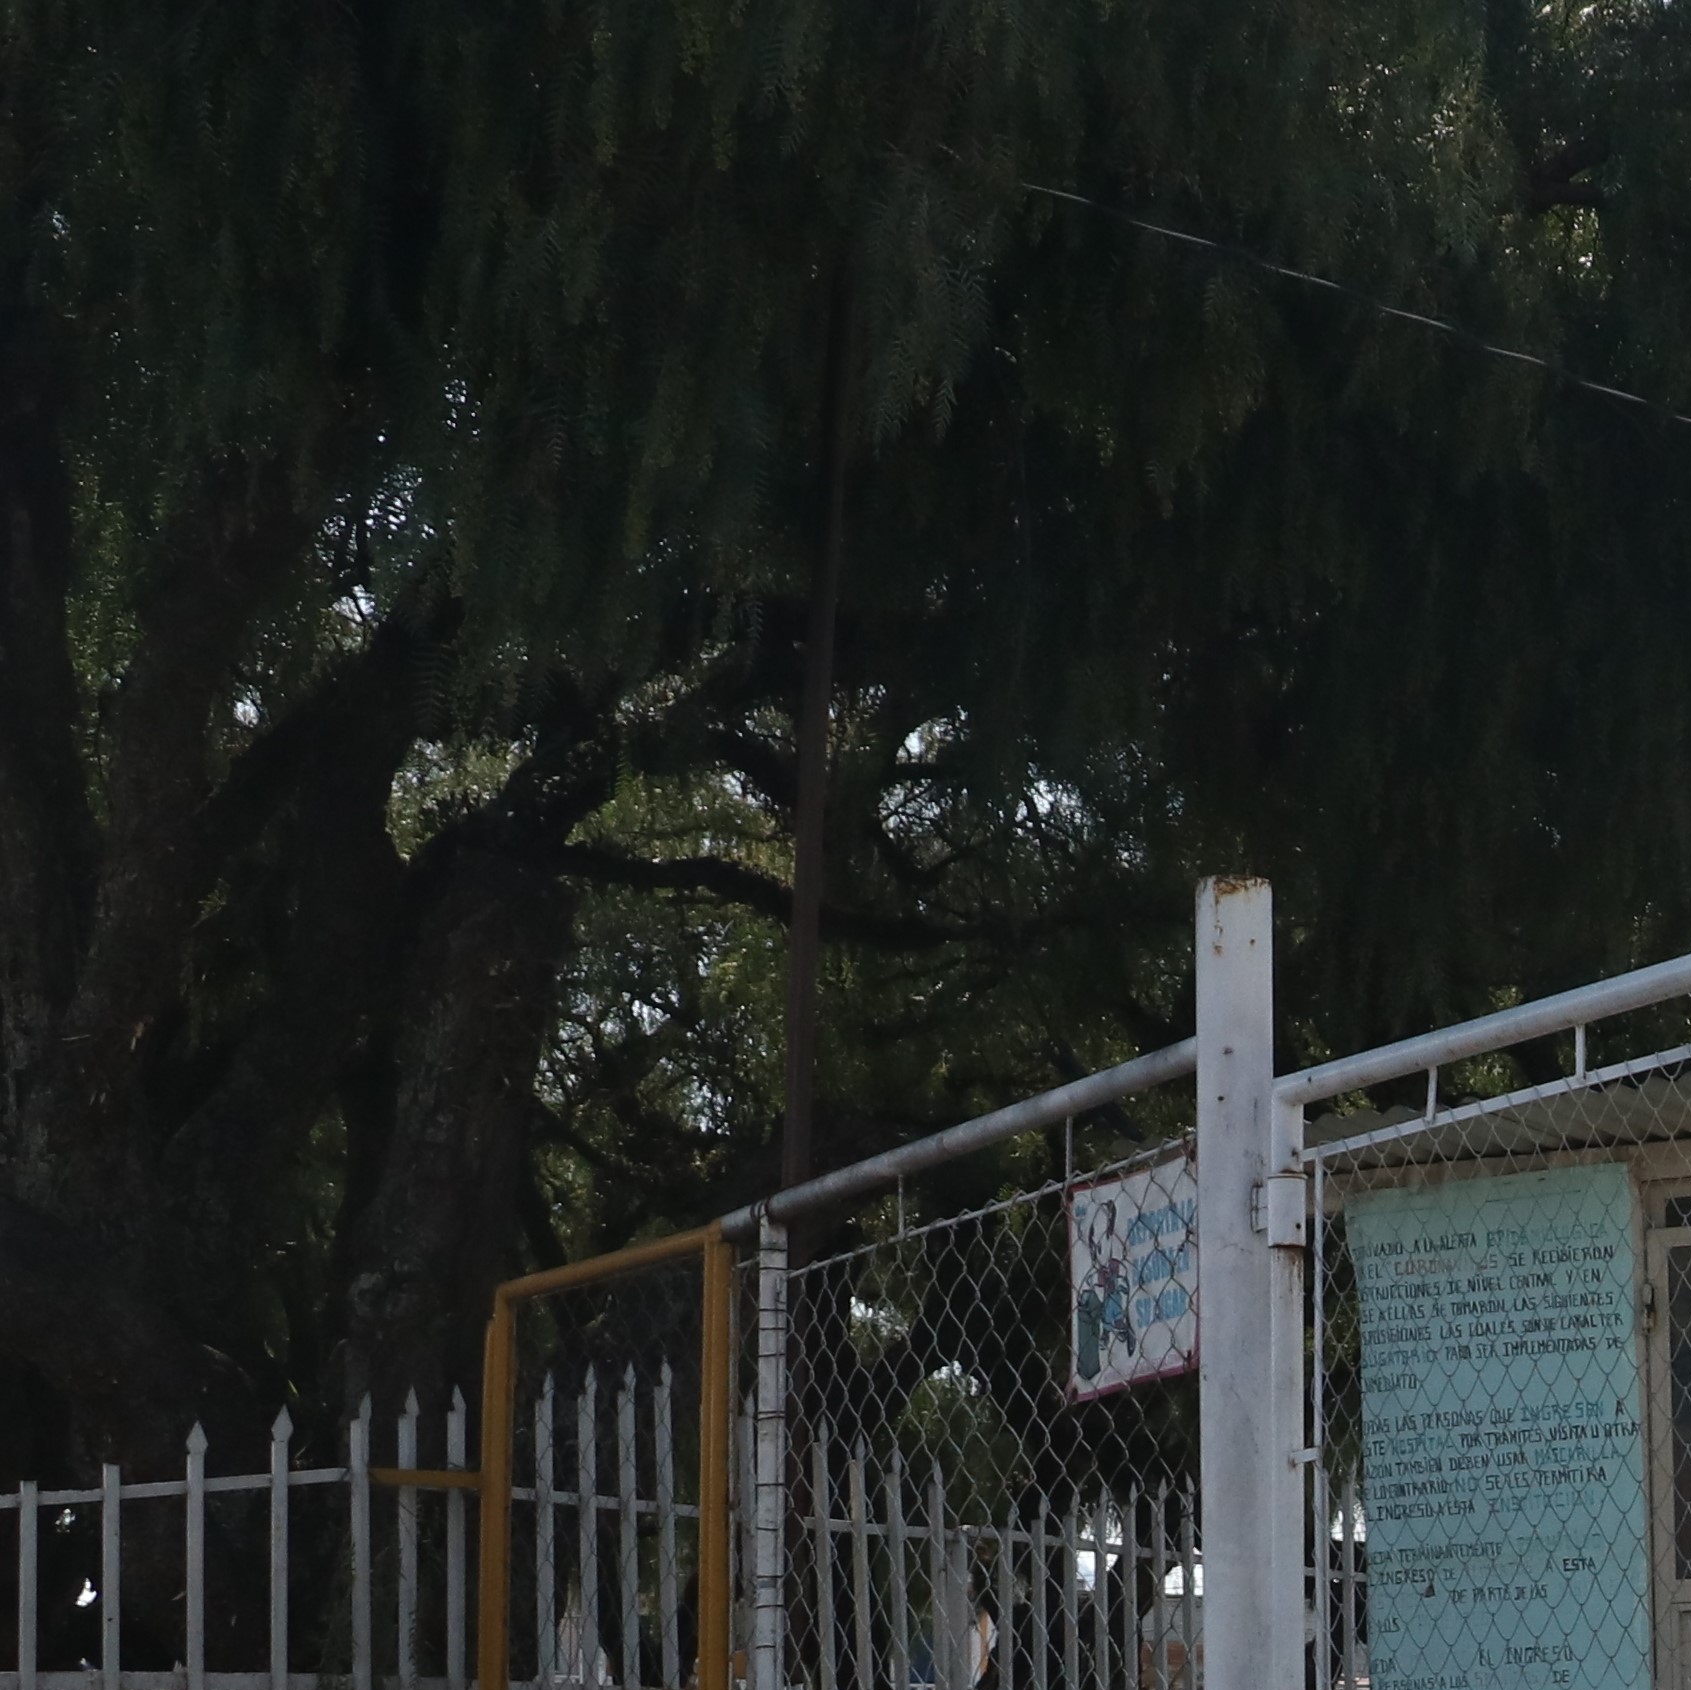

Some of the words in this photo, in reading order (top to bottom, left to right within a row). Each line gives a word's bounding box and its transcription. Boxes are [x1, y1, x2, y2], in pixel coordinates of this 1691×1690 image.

[1583, 1268, 1601, 1284] EN
[1513, 1297, 1536, 1312] LAS
[1440, 1324, 1462, 1340] LAS
[1395, 1415, 1417, 1432] LAS
[1422, 1411, 1483, 1430] PERSONAS
[1490, 1408, 1513, 1428] QUE
[1615, 1399, 1624, 1417] A
[1448, 1453, 1489, 1472] DEBEN
[1497, 1451, 1527, 1468] USAR
[1562, 1556, 1597, 1573] ESTA
[1552, 1669, 1570, 1684] DE
